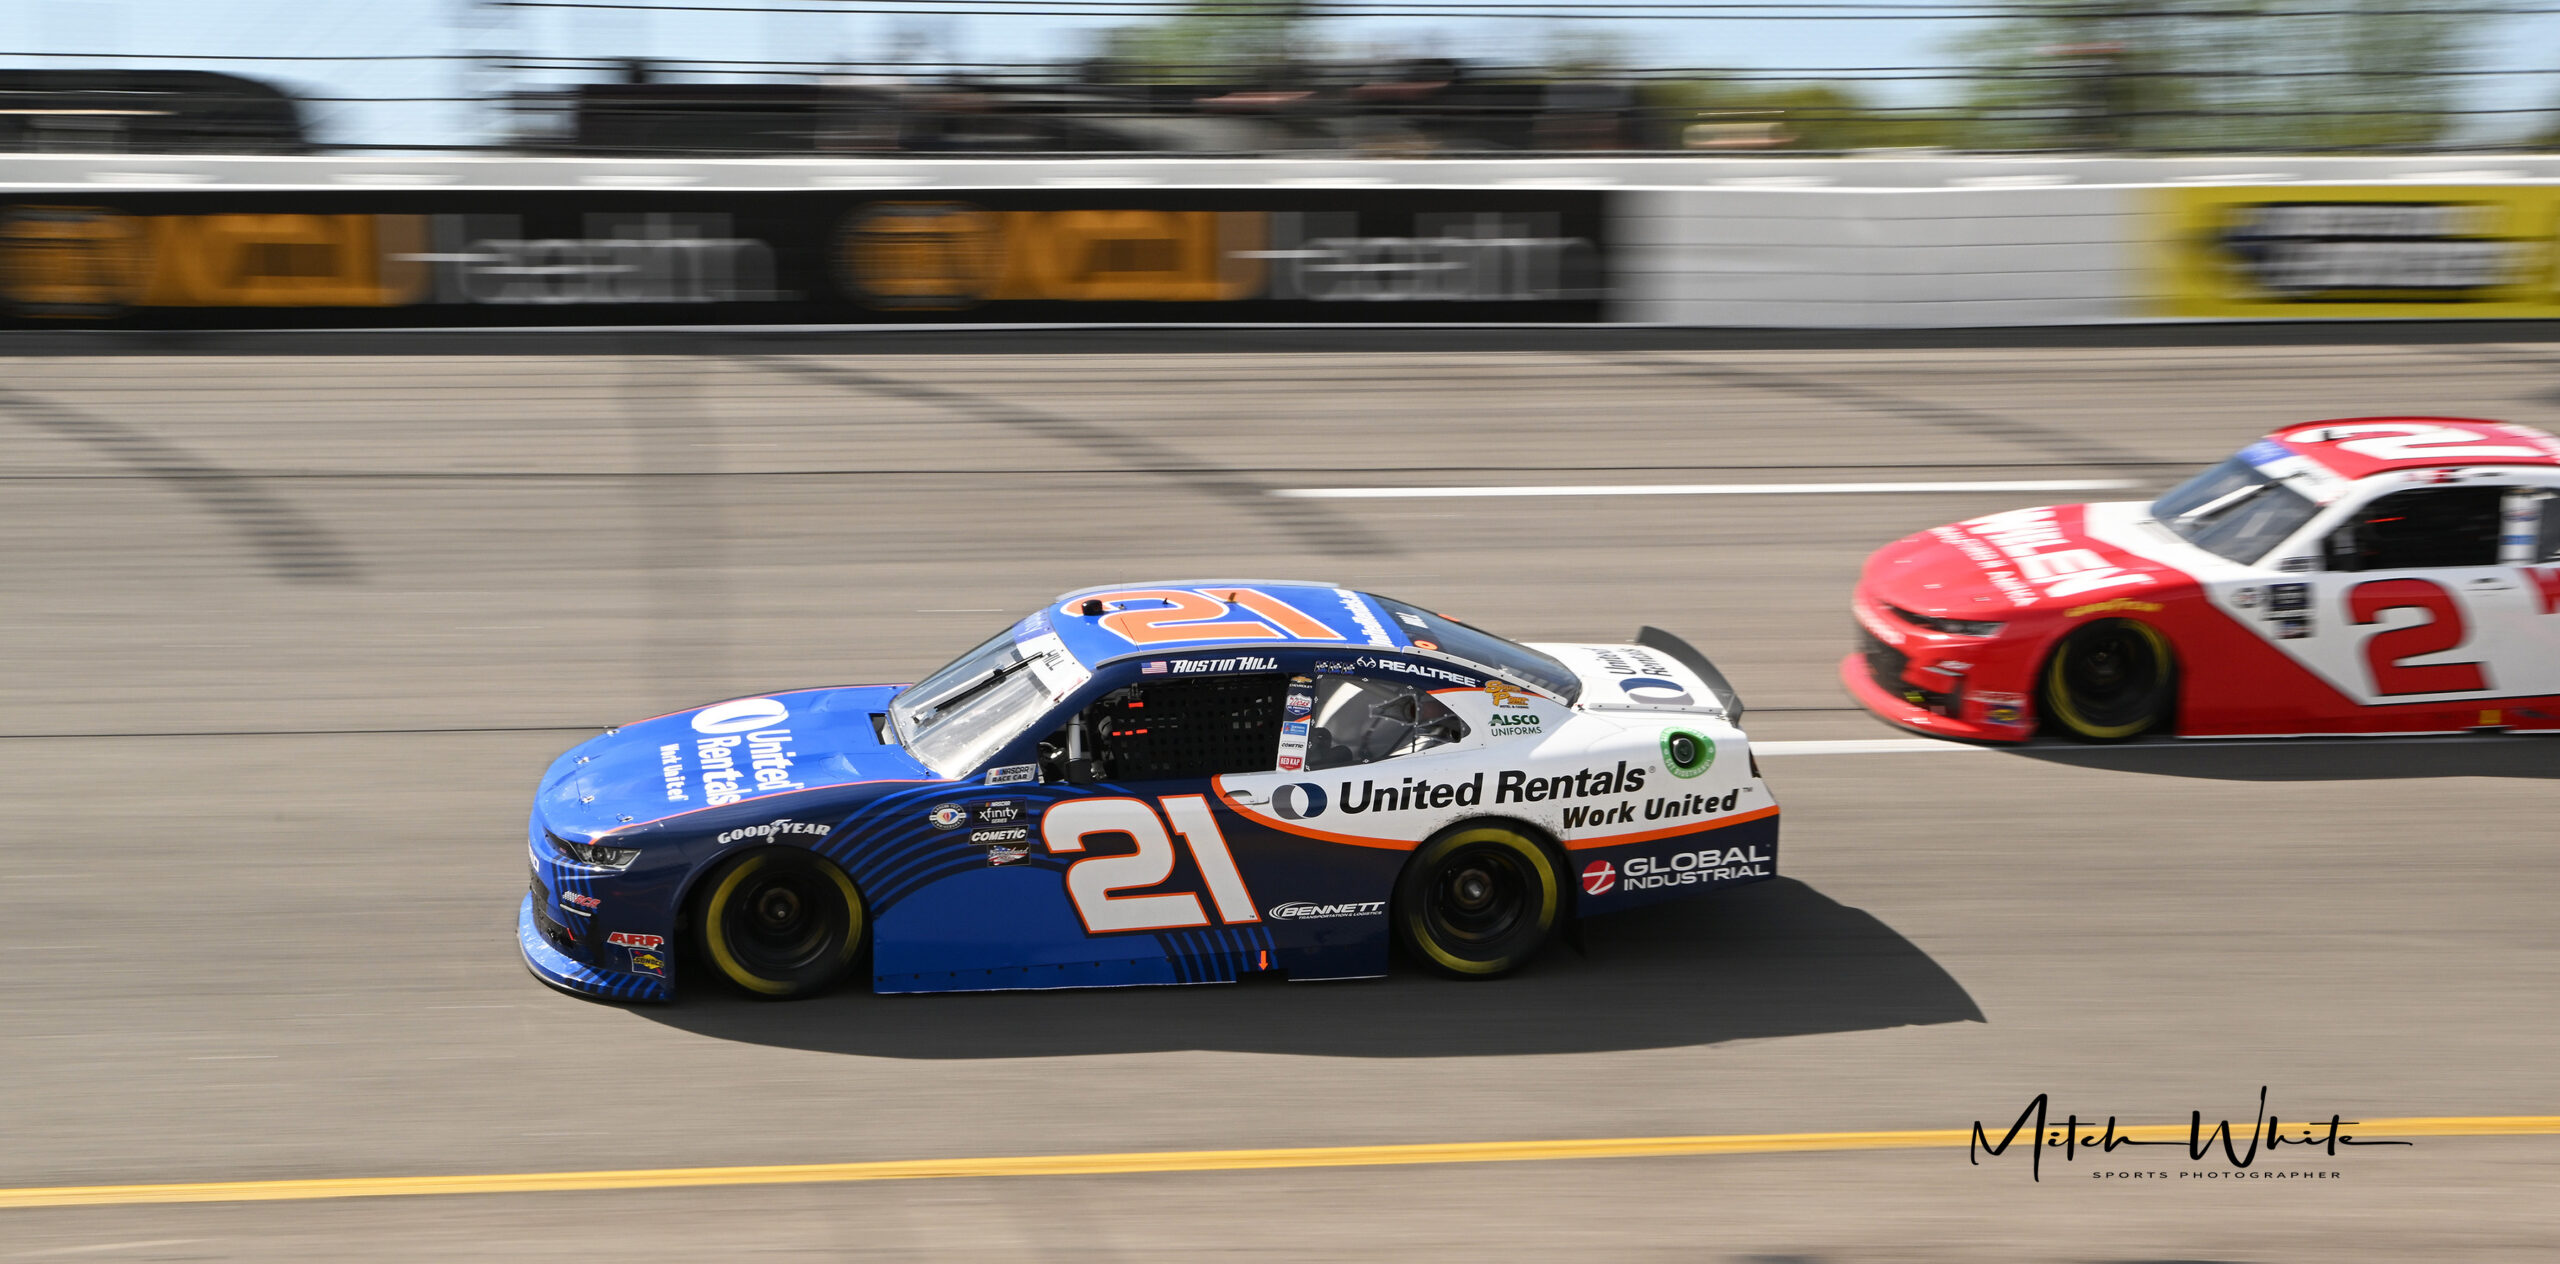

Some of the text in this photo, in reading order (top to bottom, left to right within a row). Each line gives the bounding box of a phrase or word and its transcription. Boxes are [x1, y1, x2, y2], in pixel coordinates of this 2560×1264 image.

[1958, 505, 2154, 598] WILEN
[1060, 587, 1347, 646] 21
[2339, 577, 2498, 697] 2
[1042, 649, 1064, 672] HILL
[1170, 656, 1278, 673] AUSTIN HILL
[1379, 659, 1476, 688] REALTREE
[1488, 714, 1540, 727] ALSCO
[1491, 726, 1543, 737] UNIFORMS
[697, 735, 753, 806] Rentals
[746, 729, 799, 791] United
[1002, 766, 1030, 776] NASCAR
[992, 774, 1028, 784] RACE CAR
[1339, 761, 1646, 815] United Rentals
[979, 807, 1018, 822] xfinity
[1563, 788, 1739, 829] Work United
[717, 819, 831, 844] GOODYEAR
[971, 829, 1027, 842] COMETIC
[1040, 792, 1262, 935] 21
[1624, 845, 1770, 877] GLOBAL
[1624, 864, 1770, 891] INDUSTRIAL
[1281, 901, 1386, 917] BENNETT
[607, 931, 665, 951] ARP
